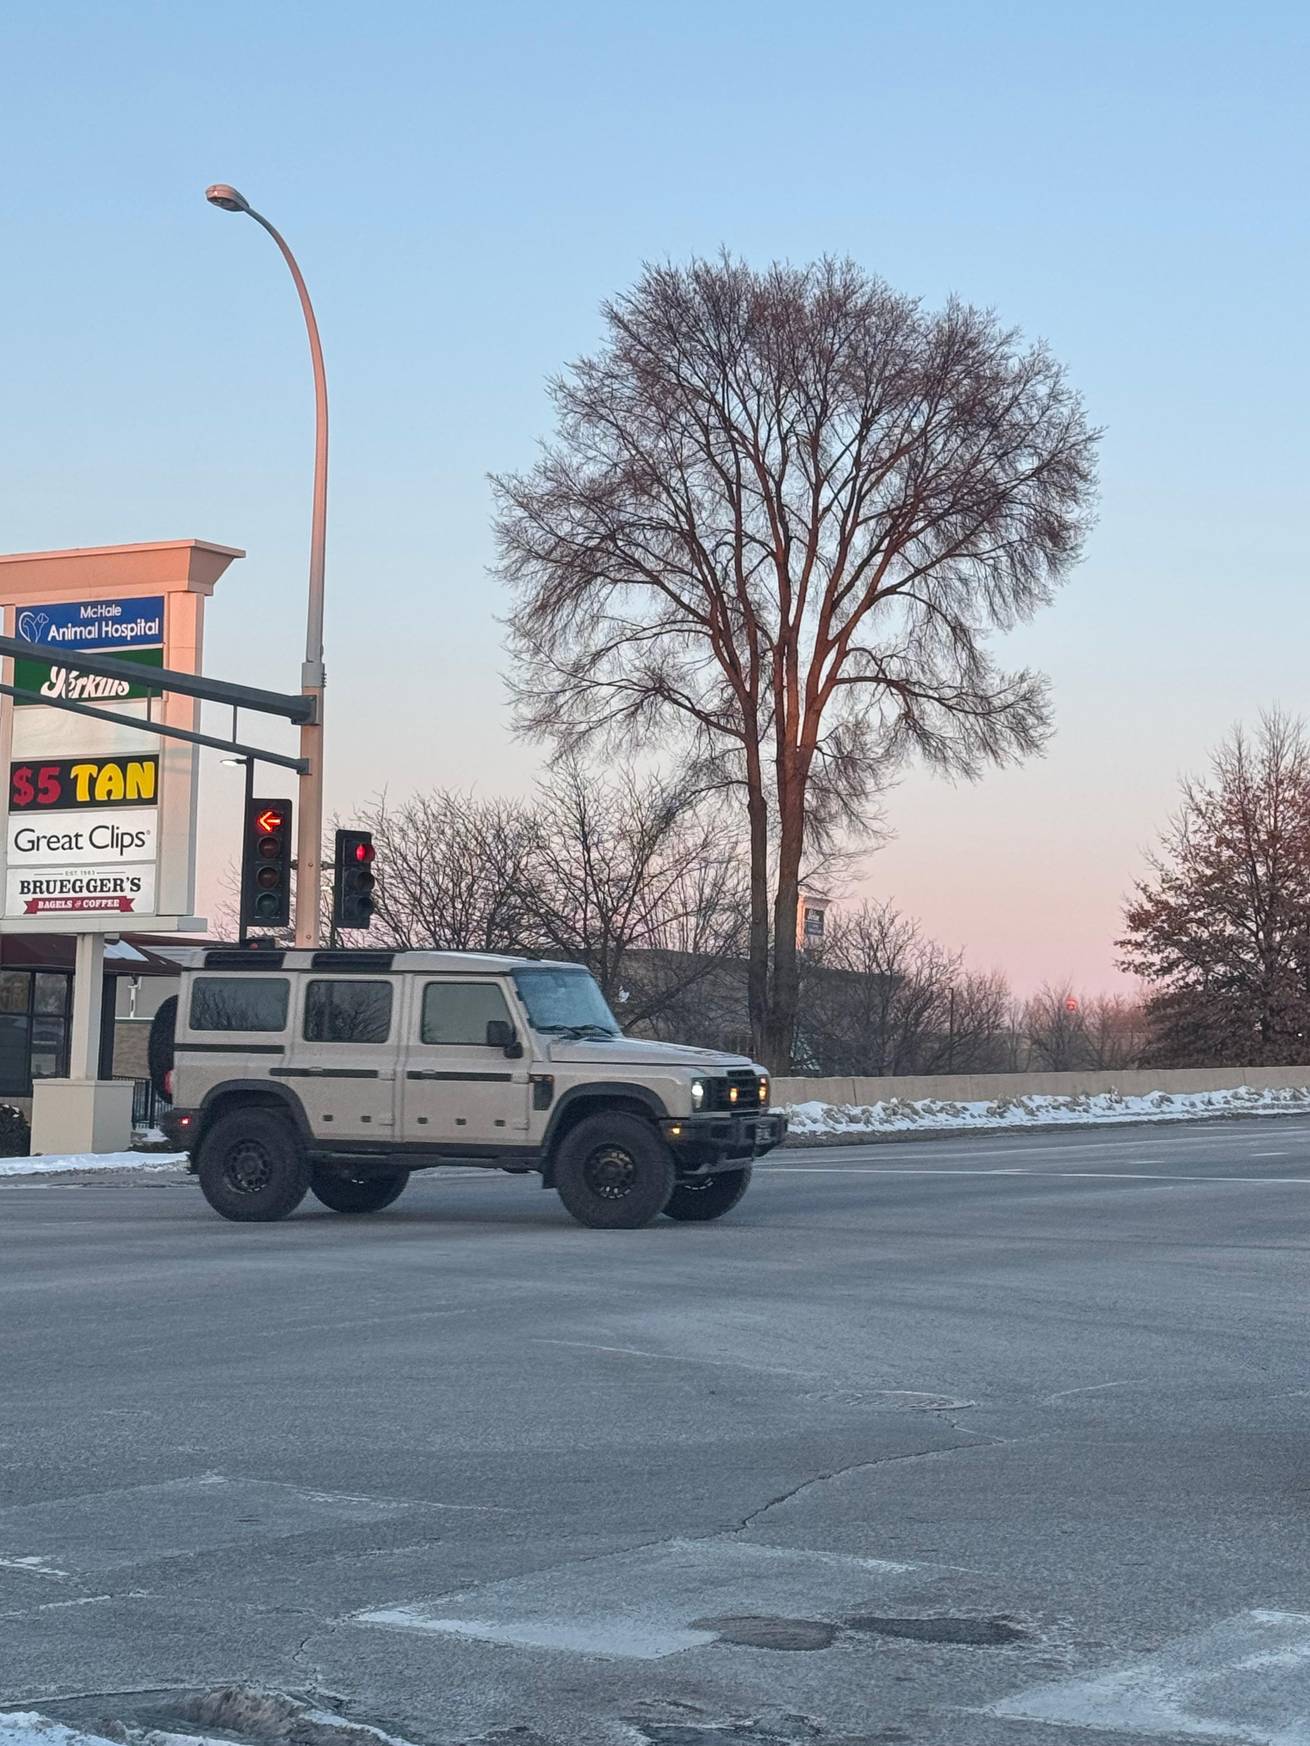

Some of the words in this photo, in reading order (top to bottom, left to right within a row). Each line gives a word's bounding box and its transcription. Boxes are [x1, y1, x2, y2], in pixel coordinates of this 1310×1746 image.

[80, 604, 122, 619] McHale
[47, 622, 98, 641] Animal
[101, 618, 159, 641] Hospital
[12, 767, 61, 806] $5
[70, 761, 155, 802] TAN
[14, 828, 84, 852] Great
[19, 877, 142, 895] BRUEGGER'S
[38, 901, 73, 909] BAGELS
[83, 899, 120, 908] COFFEE
